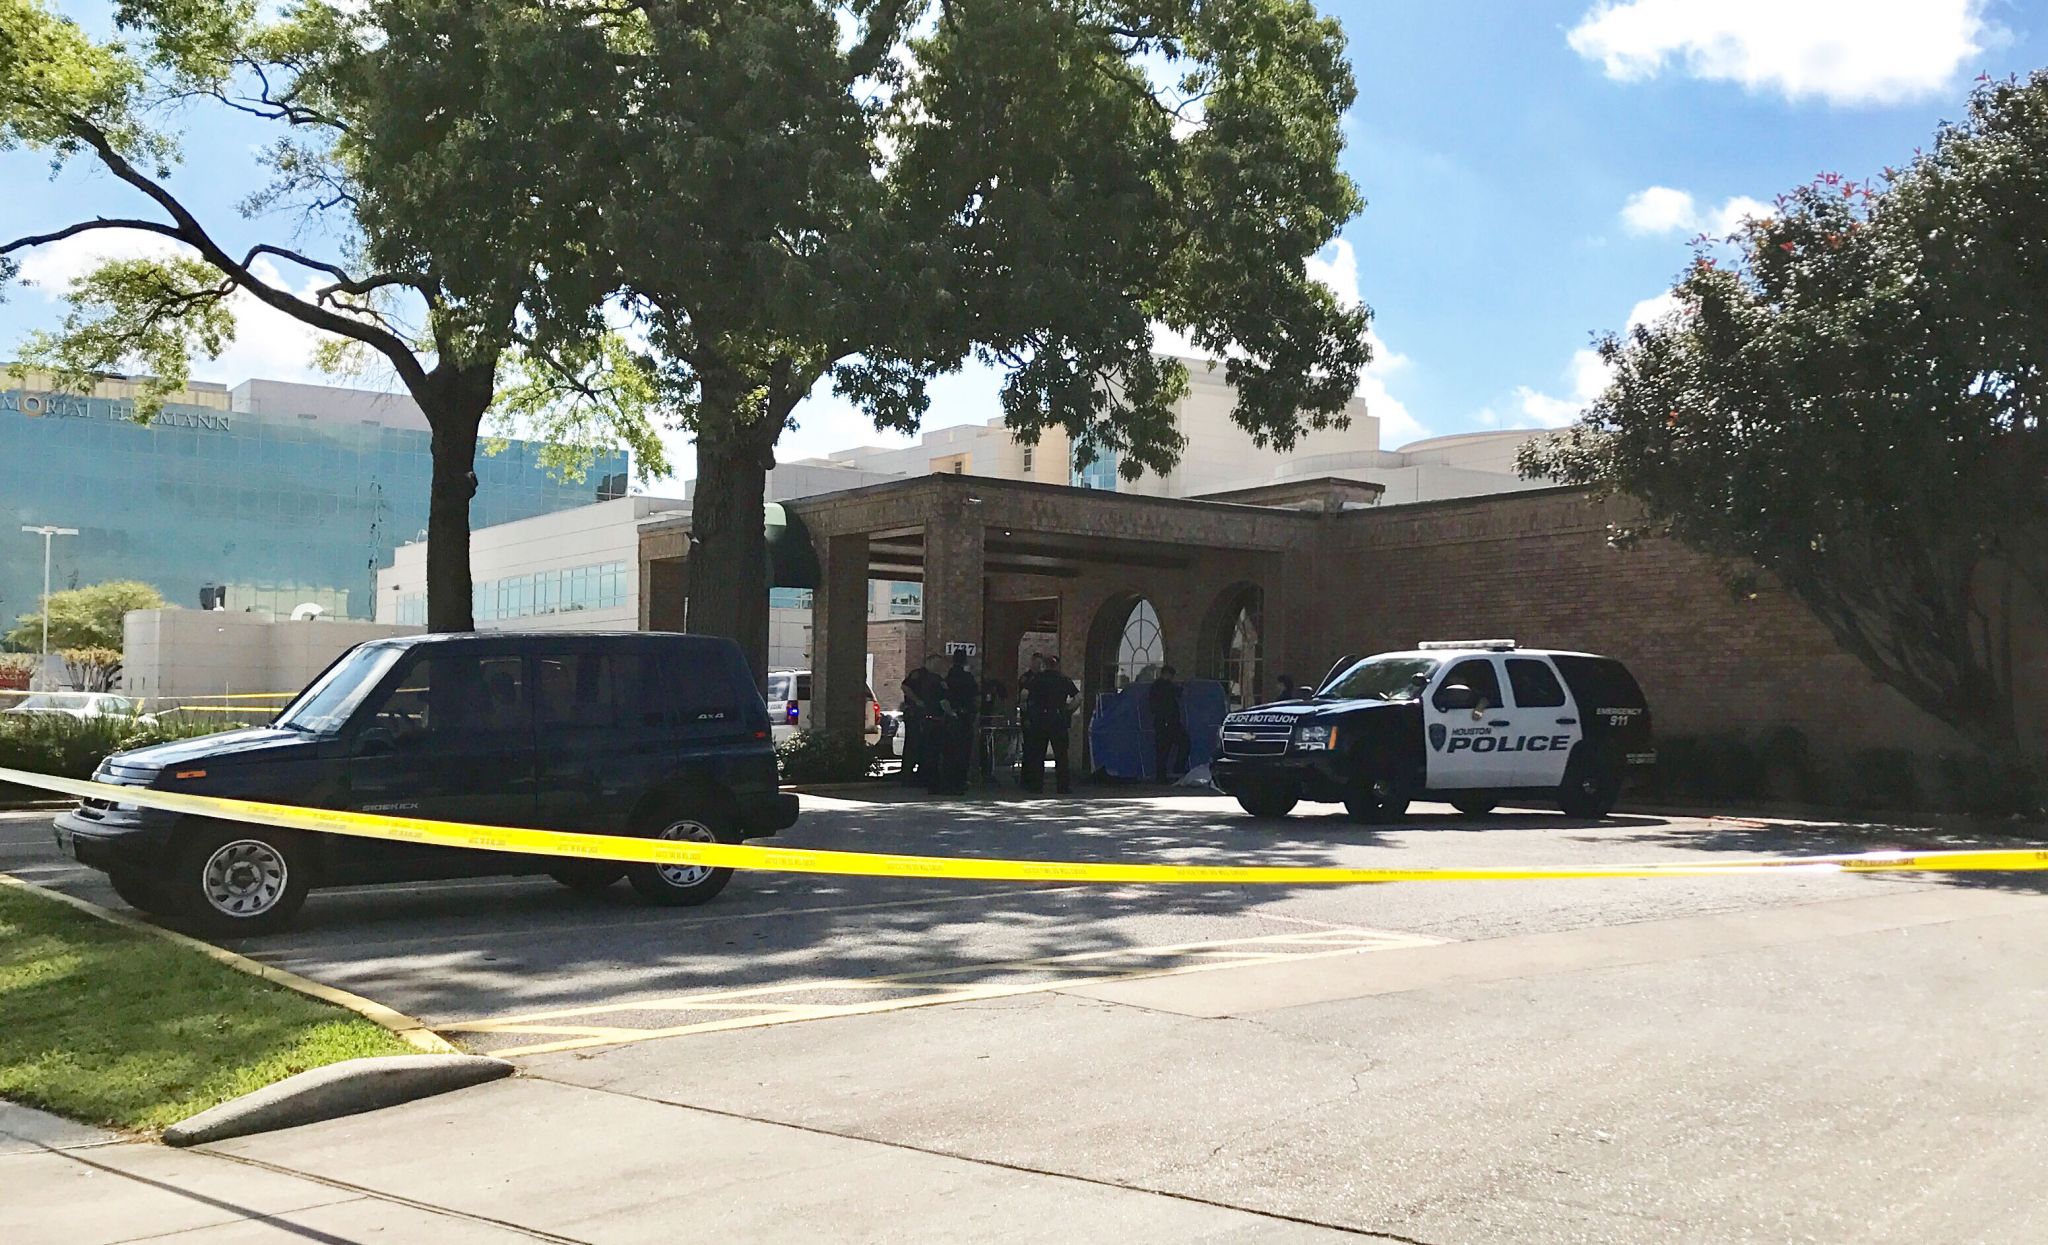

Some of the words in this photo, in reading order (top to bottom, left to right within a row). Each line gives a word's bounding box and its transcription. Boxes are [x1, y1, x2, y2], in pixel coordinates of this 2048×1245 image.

[108, 404, 230, 432] HMANN
[1610, 715, 1629, 726] 911
[1451, 727, 1492, 736] HOUSTON
[1446, 735, 1571, 754] POLICE
[362, 802, 419, 812] SIDEKICK
